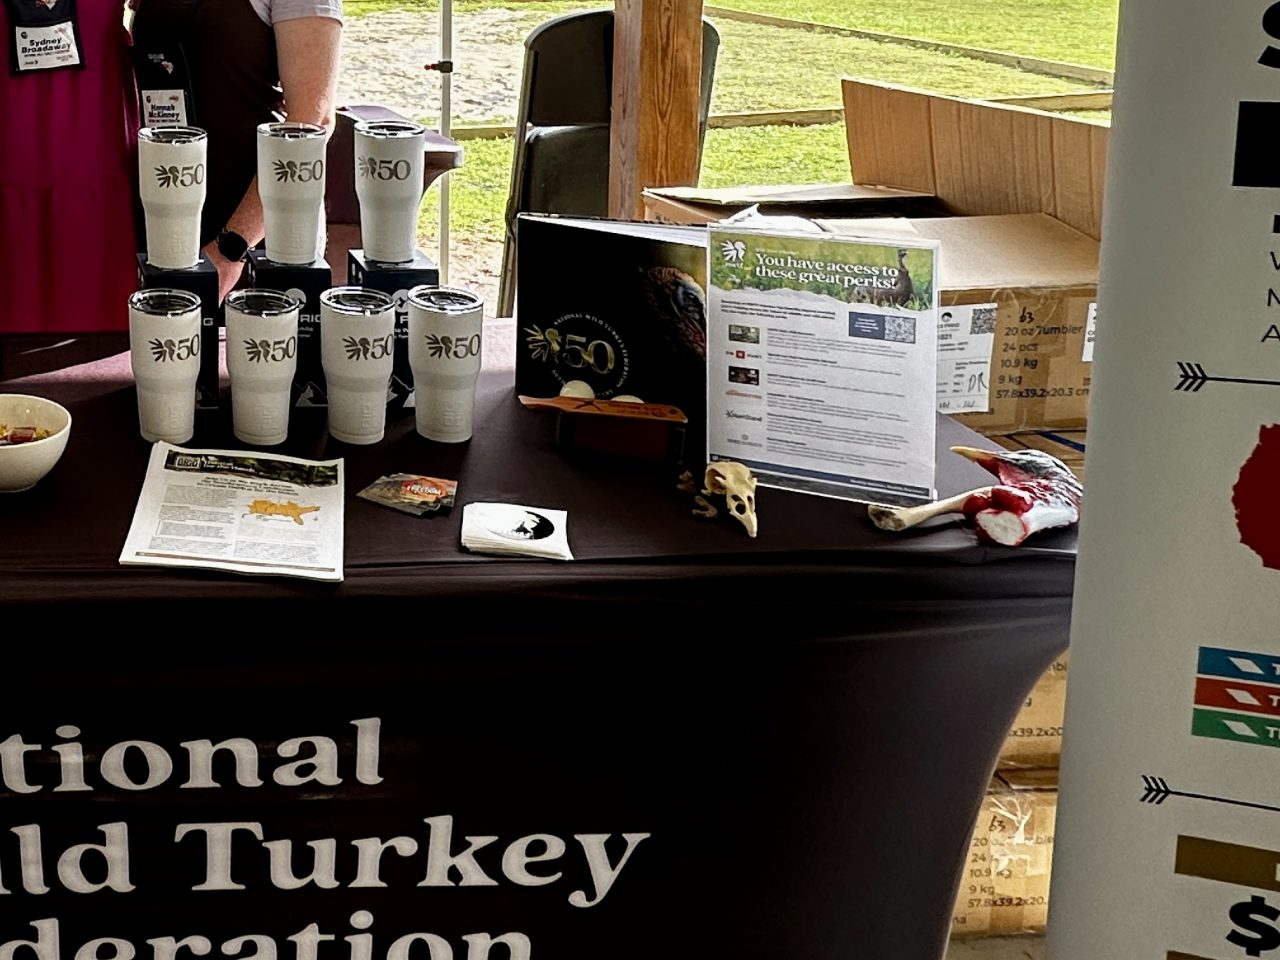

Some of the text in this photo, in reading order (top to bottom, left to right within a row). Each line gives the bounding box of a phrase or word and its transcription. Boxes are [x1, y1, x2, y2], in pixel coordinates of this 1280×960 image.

[29, 37, 62, 47] Sydney
[179, 162, 205, 187] 50
[297, 159, 324, 182] 50
[377, 159, 411, 181] 50
[756, 253, 898, 277] You have access to
[756, 265, 896, 290] these great perks!
[1005, 325, 1083, 336] 20 oz Tumbler
[176, 332, 200, 362] 50
[271, 333, 296, 363] 50
[453, 331, 481, 360] 50
[1002, 343, 1016, 352] 24
[562, 334, 615, 374] 50
[1024, 359, 1038, 370] kg
[998, 375, 1023, 386] 9 kg
[973, 838, 988, 847] 20
[173, 814, 652, 909] Turkey
[972, 853, 986, 862] 24
[970, 868, 991, 878] 10.9
[969, 885, 995, 895] 9 kg
[968, 897, 1048, 908] 57.8x39.2x20.
